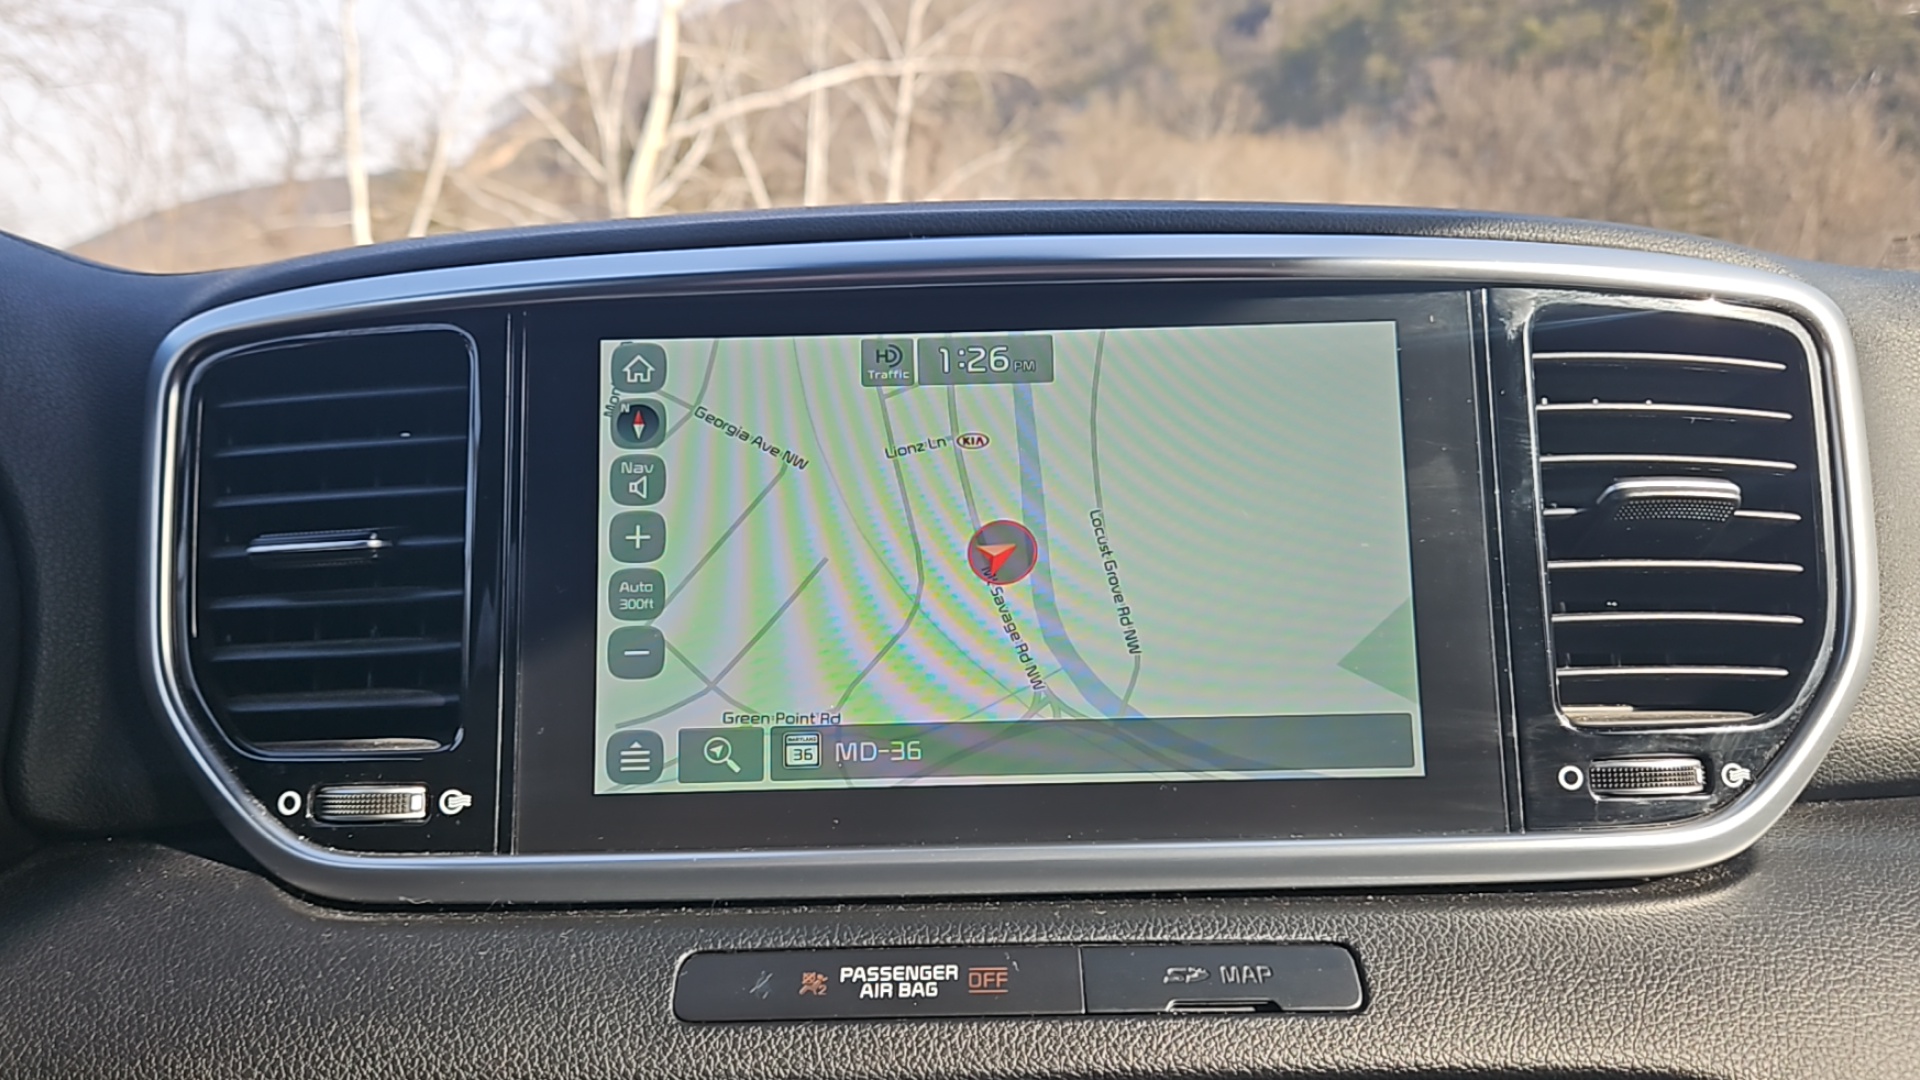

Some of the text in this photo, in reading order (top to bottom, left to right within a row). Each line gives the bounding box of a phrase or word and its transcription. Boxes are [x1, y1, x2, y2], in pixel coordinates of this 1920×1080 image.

[938, 346, 1036, 373] 1:26 PM
[867, 370, 910, 380] Traffic
[694, 405, 810, 471] Georgia Ave NW
[961, 435, 986, 447] KIA
[884, 437, 947, 459] Lionz Ln
[620, 462, 654, 474] Nav
[619, 582, 654, 593] Auto
[1089, 509, 1143, 655] Locust Grove Rd NW
[619, 599, 654, 610] 300ft
[990, 586, 1021, 642] Savage
[1015, 643, 1033, 663] Rd
[1025, 665, 1047, 691] NW
[722, 711, 841, 724] Green Point Rd
[793, 748, 813, 761] 36
[835, 740, 922, 762] MD-36
[839, 964, 959, 983] PASSENGER
[968, 971, 1009, 988] OFF
[1219, 965, 1272, 984] MAP
[859, 981, 939, 998] AIR BAG
